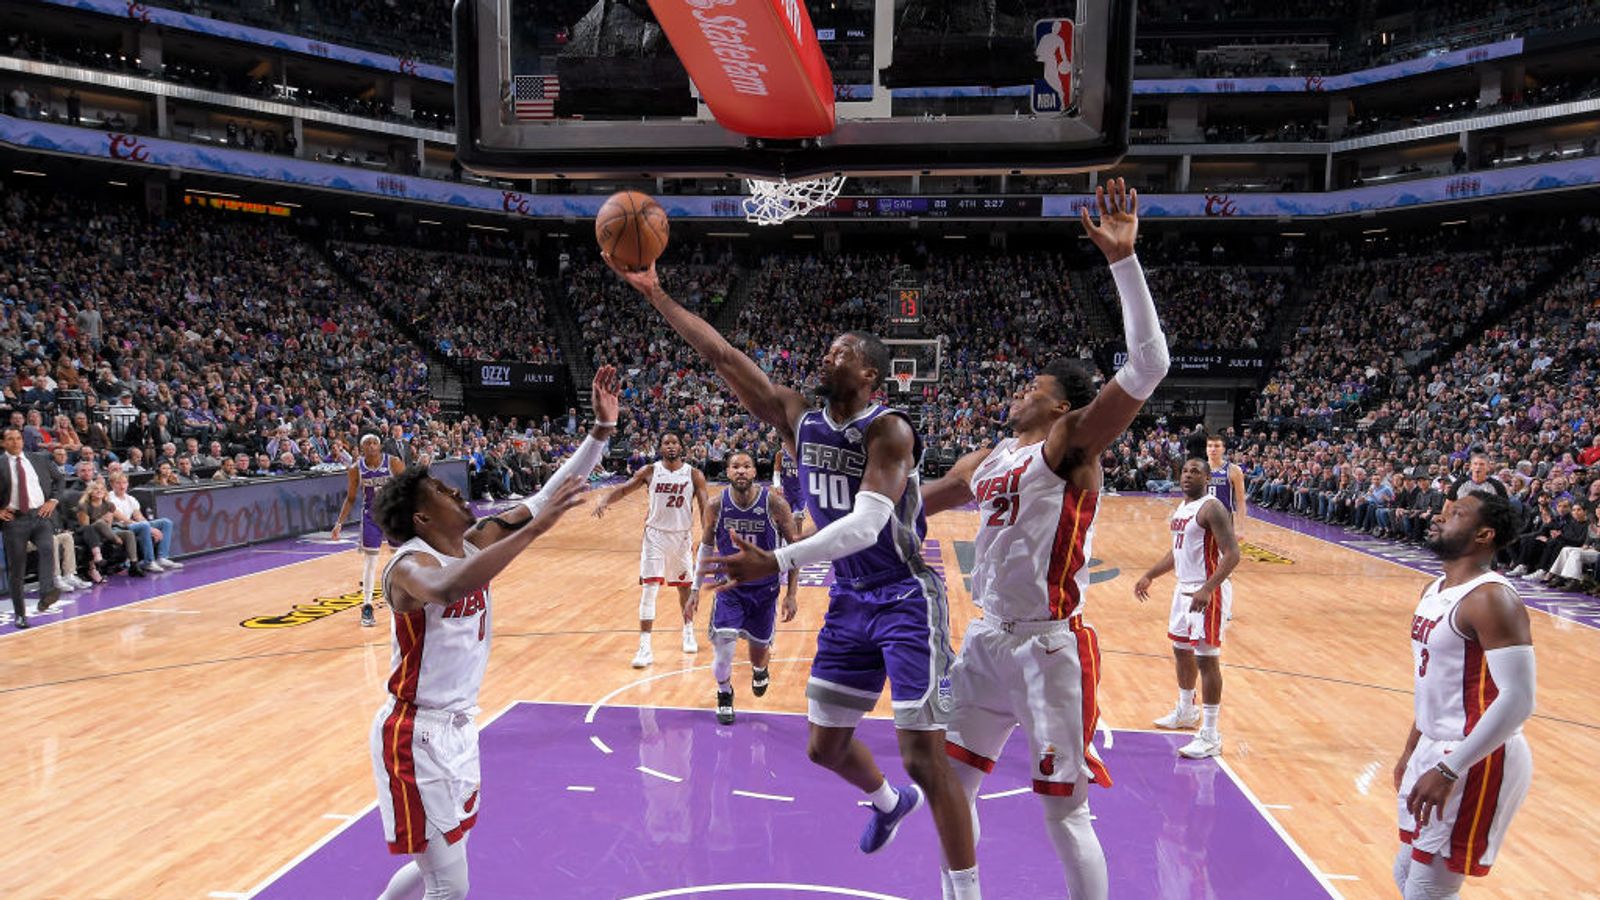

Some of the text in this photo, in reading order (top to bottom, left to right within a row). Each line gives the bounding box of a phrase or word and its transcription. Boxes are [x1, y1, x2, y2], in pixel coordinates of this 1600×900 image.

[1037, 93, 1056, 110] NBA
[959, 200, 976, 208] 4TH
[901, 301, 917, 317] 13
[1228, 359, 1249, 367] JULY
[481, 365, 511, 381] OZZY
[523, 374, 544, 382] JULY
[802, 442, 866, 477] SAC
[976, 455, 1034, 502] HEAT
[654, 481, 689, 495] HEAT
[809, 471, 851, 510] 40
[666, 496, 686, 508] 20
[986, 496, 1020, 527] 21
[175, 489, 284, 552] Coors
[724, 518, 765, 533] SAC
[1419, 648, 1429, 678] 3
